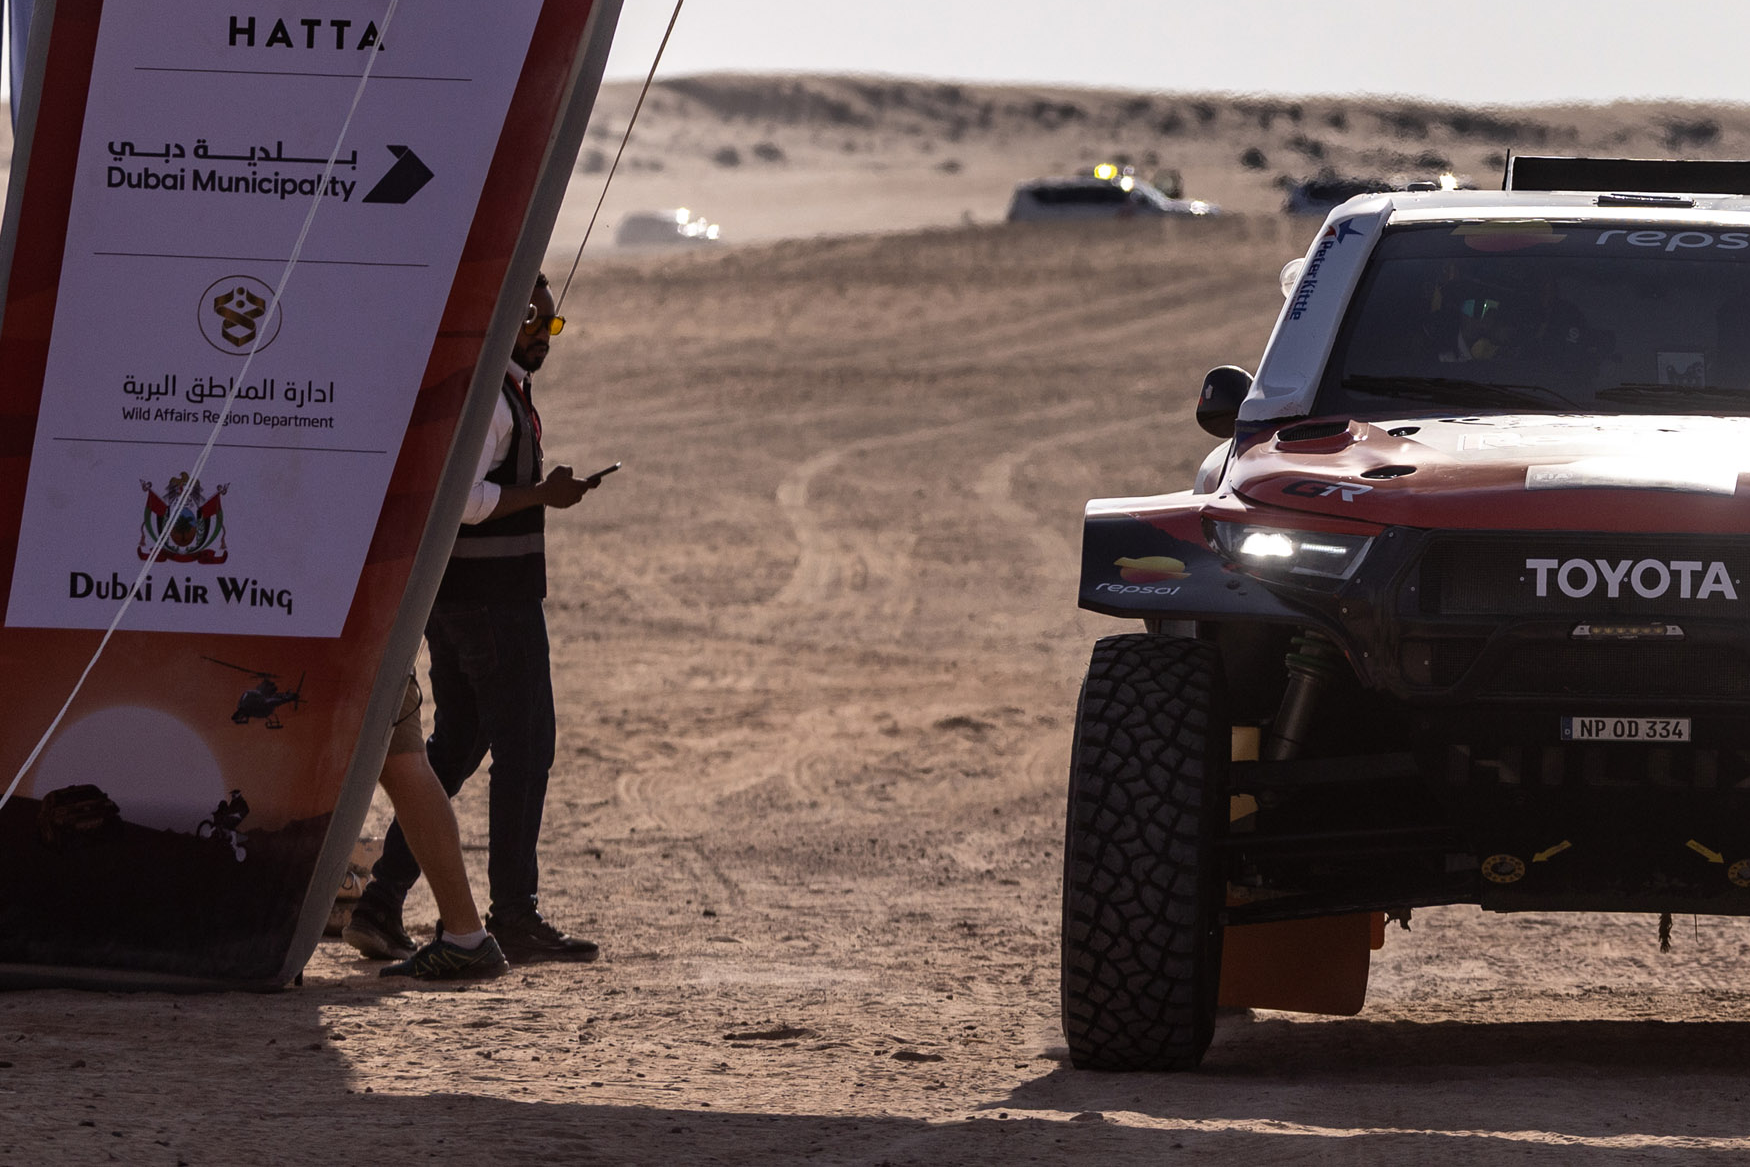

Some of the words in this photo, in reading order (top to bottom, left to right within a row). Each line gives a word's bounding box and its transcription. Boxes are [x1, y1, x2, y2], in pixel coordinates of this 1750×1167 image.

[229, 16, 384, 51] HATTA
[108, 142, 185, 163] دبي
[193, 139, 357, 170] بلدية
[107, 166, 185, 190] Dubai
[1306, 241, 1334, 280] Peter
[1289, 279, 1318, 320] Kittle
[123, 375, 176, 401] البرية
[122, 407, 150, 421] Wild
[154, 408, 198, 422] Affairs
[253, 412, 333, 428] Department
[1094, 581, 1181, 597] repsol
[1524, 556, 1740, 601] TOYOTA
[1580, 720, 1606, 737] NP
[1646, 721, 1683, 739] 334
